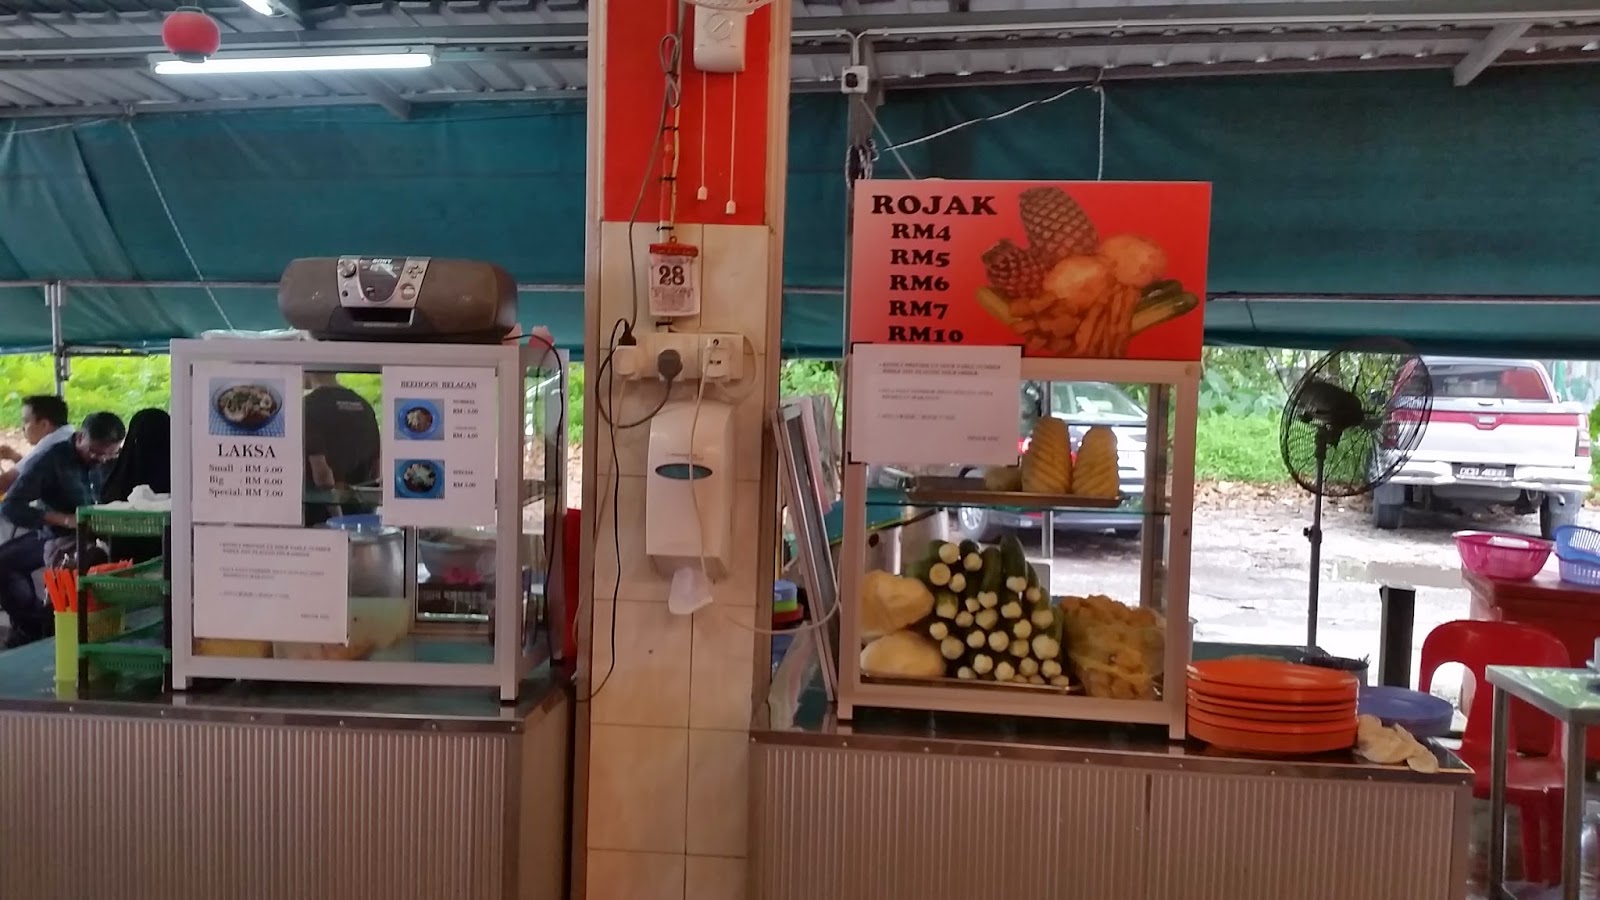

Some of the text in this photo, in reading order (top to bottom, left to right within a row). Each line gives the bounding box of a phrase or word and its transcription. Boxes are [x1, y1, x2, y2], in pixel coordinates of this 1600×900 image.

[872, 195, 998, 215] ROJAK
[891, 223, 951, 241] RM4
[890, 249, 950, 267] RM5
[659, 265, 685, 286] 28
[889, 274, 950, 291] RM6
[889, 300, 949, 320] RM7
[888, 325, 964, 343] RM10
[401, 381, 477, 389] BEEHOON BELACAN
[218, 443, 276, 458] LAKSA
[208, 464, 234, 473] Small
[245, 464, 261, 473] RM
[209, 475, 224, 486] Big
[245, 476, 261, 485] RM
[245, 488, 261, 497] RM
